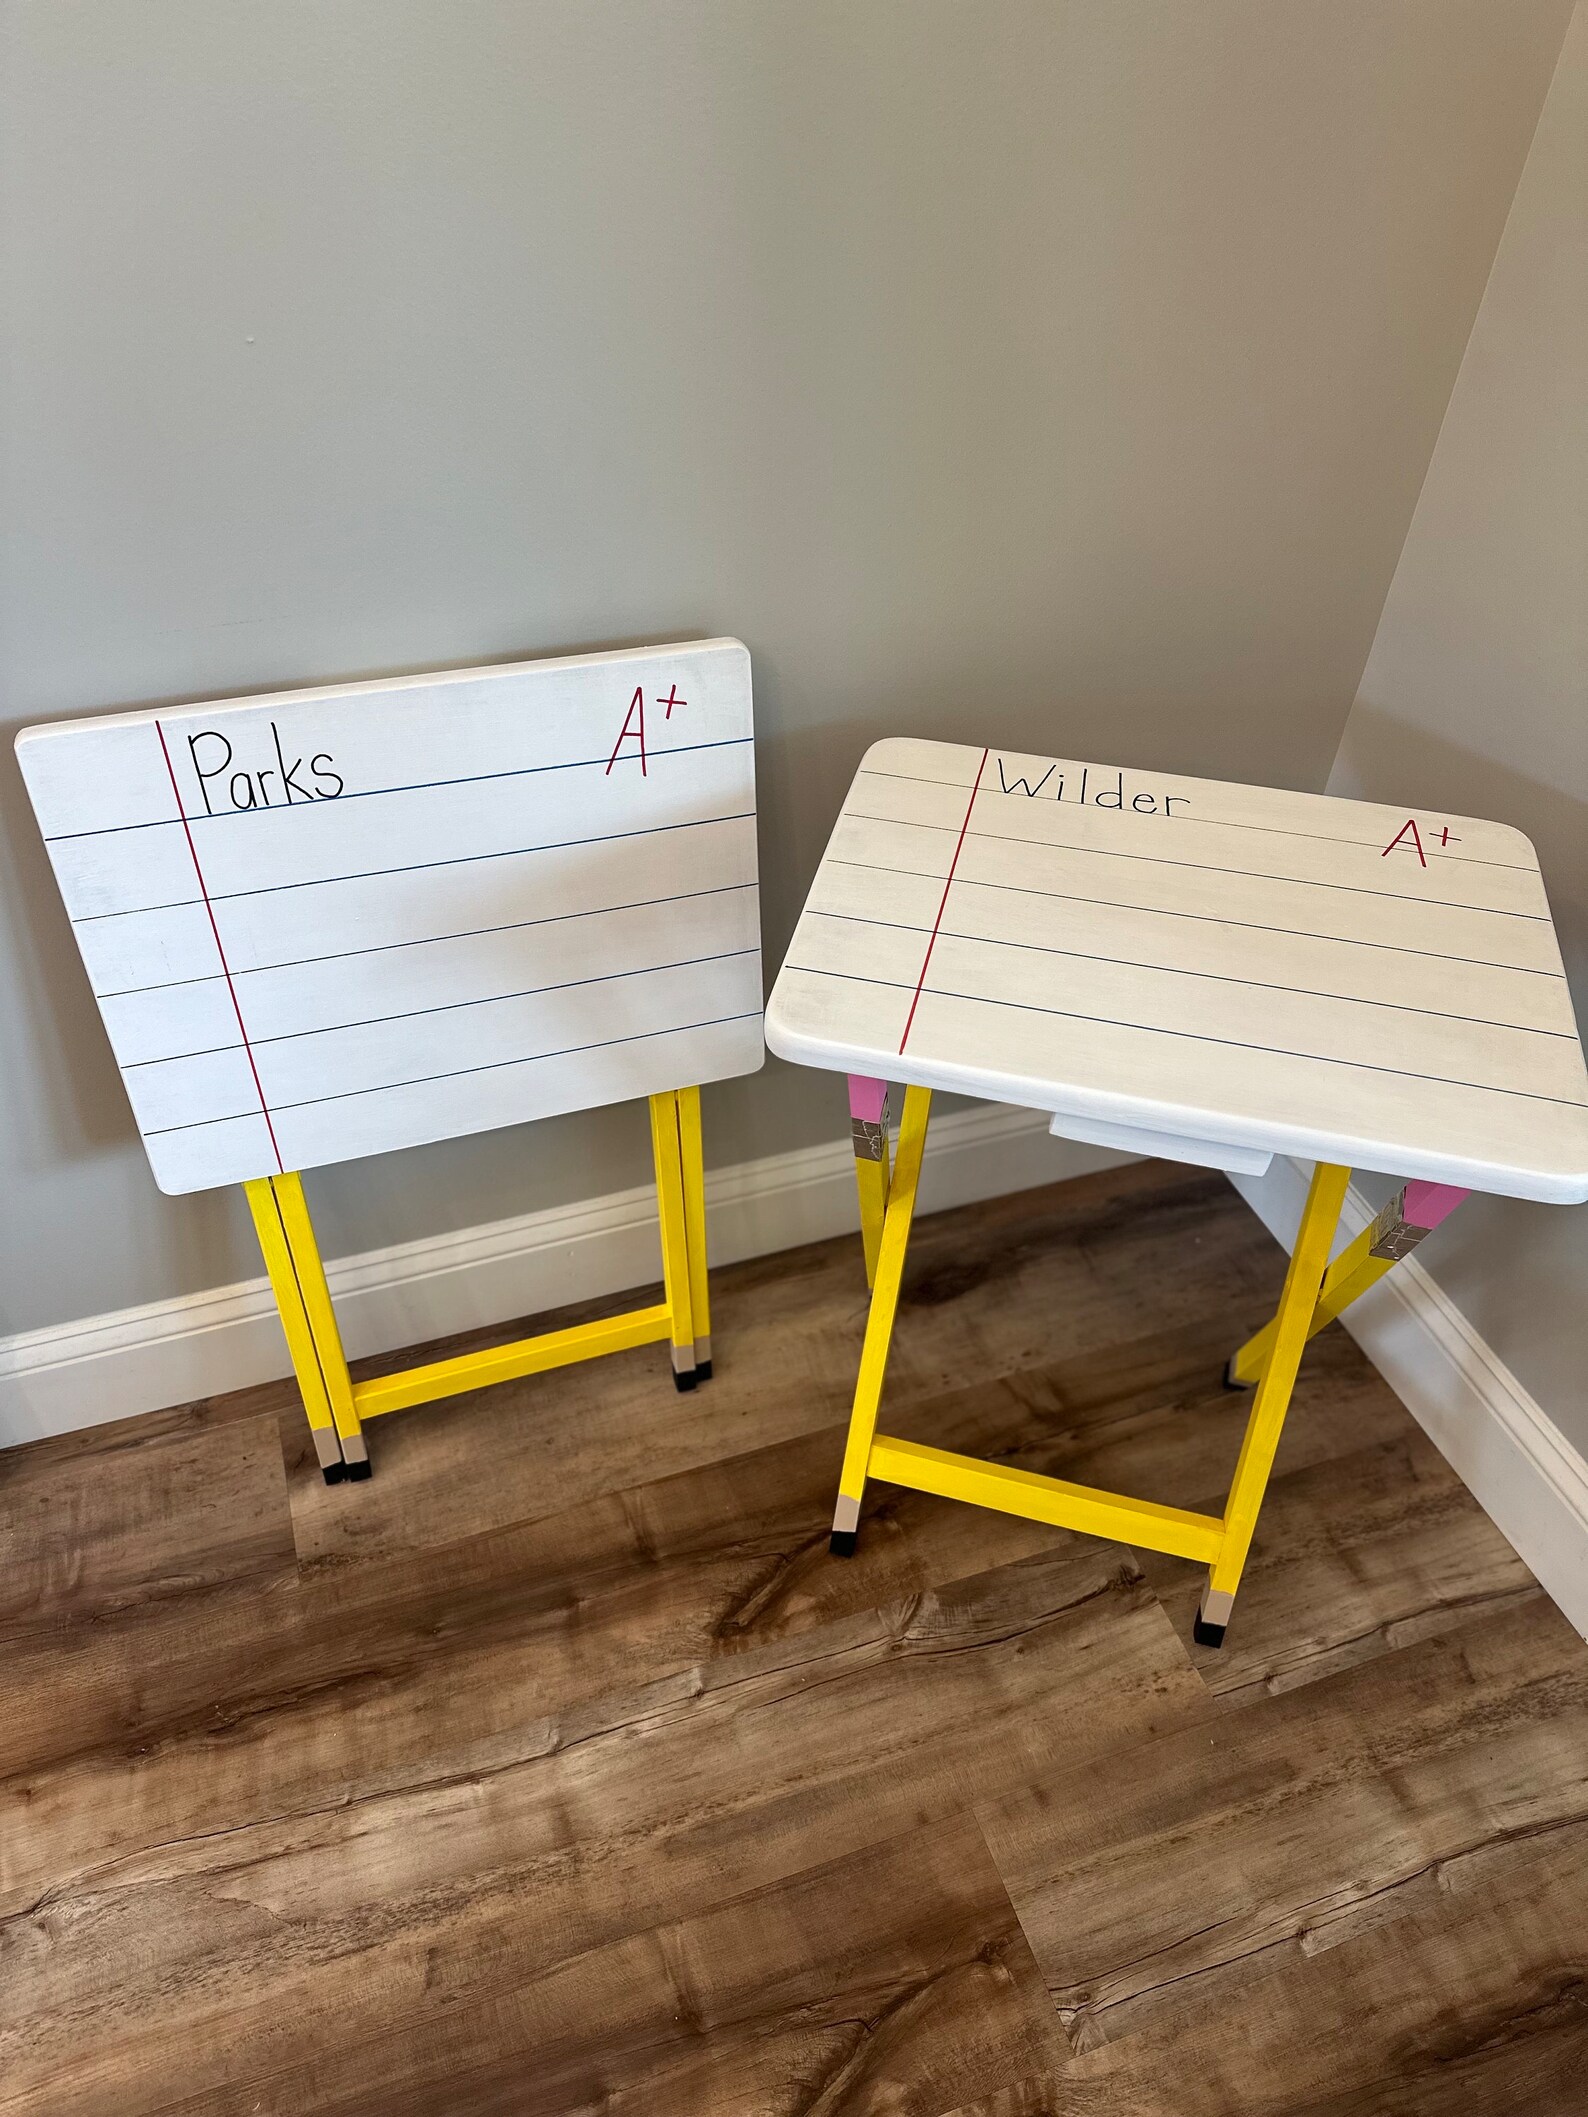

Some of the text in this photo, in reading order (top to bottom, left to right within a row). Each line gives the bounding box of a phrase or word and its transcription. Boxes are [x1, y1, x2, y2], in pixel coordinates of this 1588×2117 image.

[187, 683, 688, 815] Parks A+
[997, 757, 1463, 868] Wilder A+
